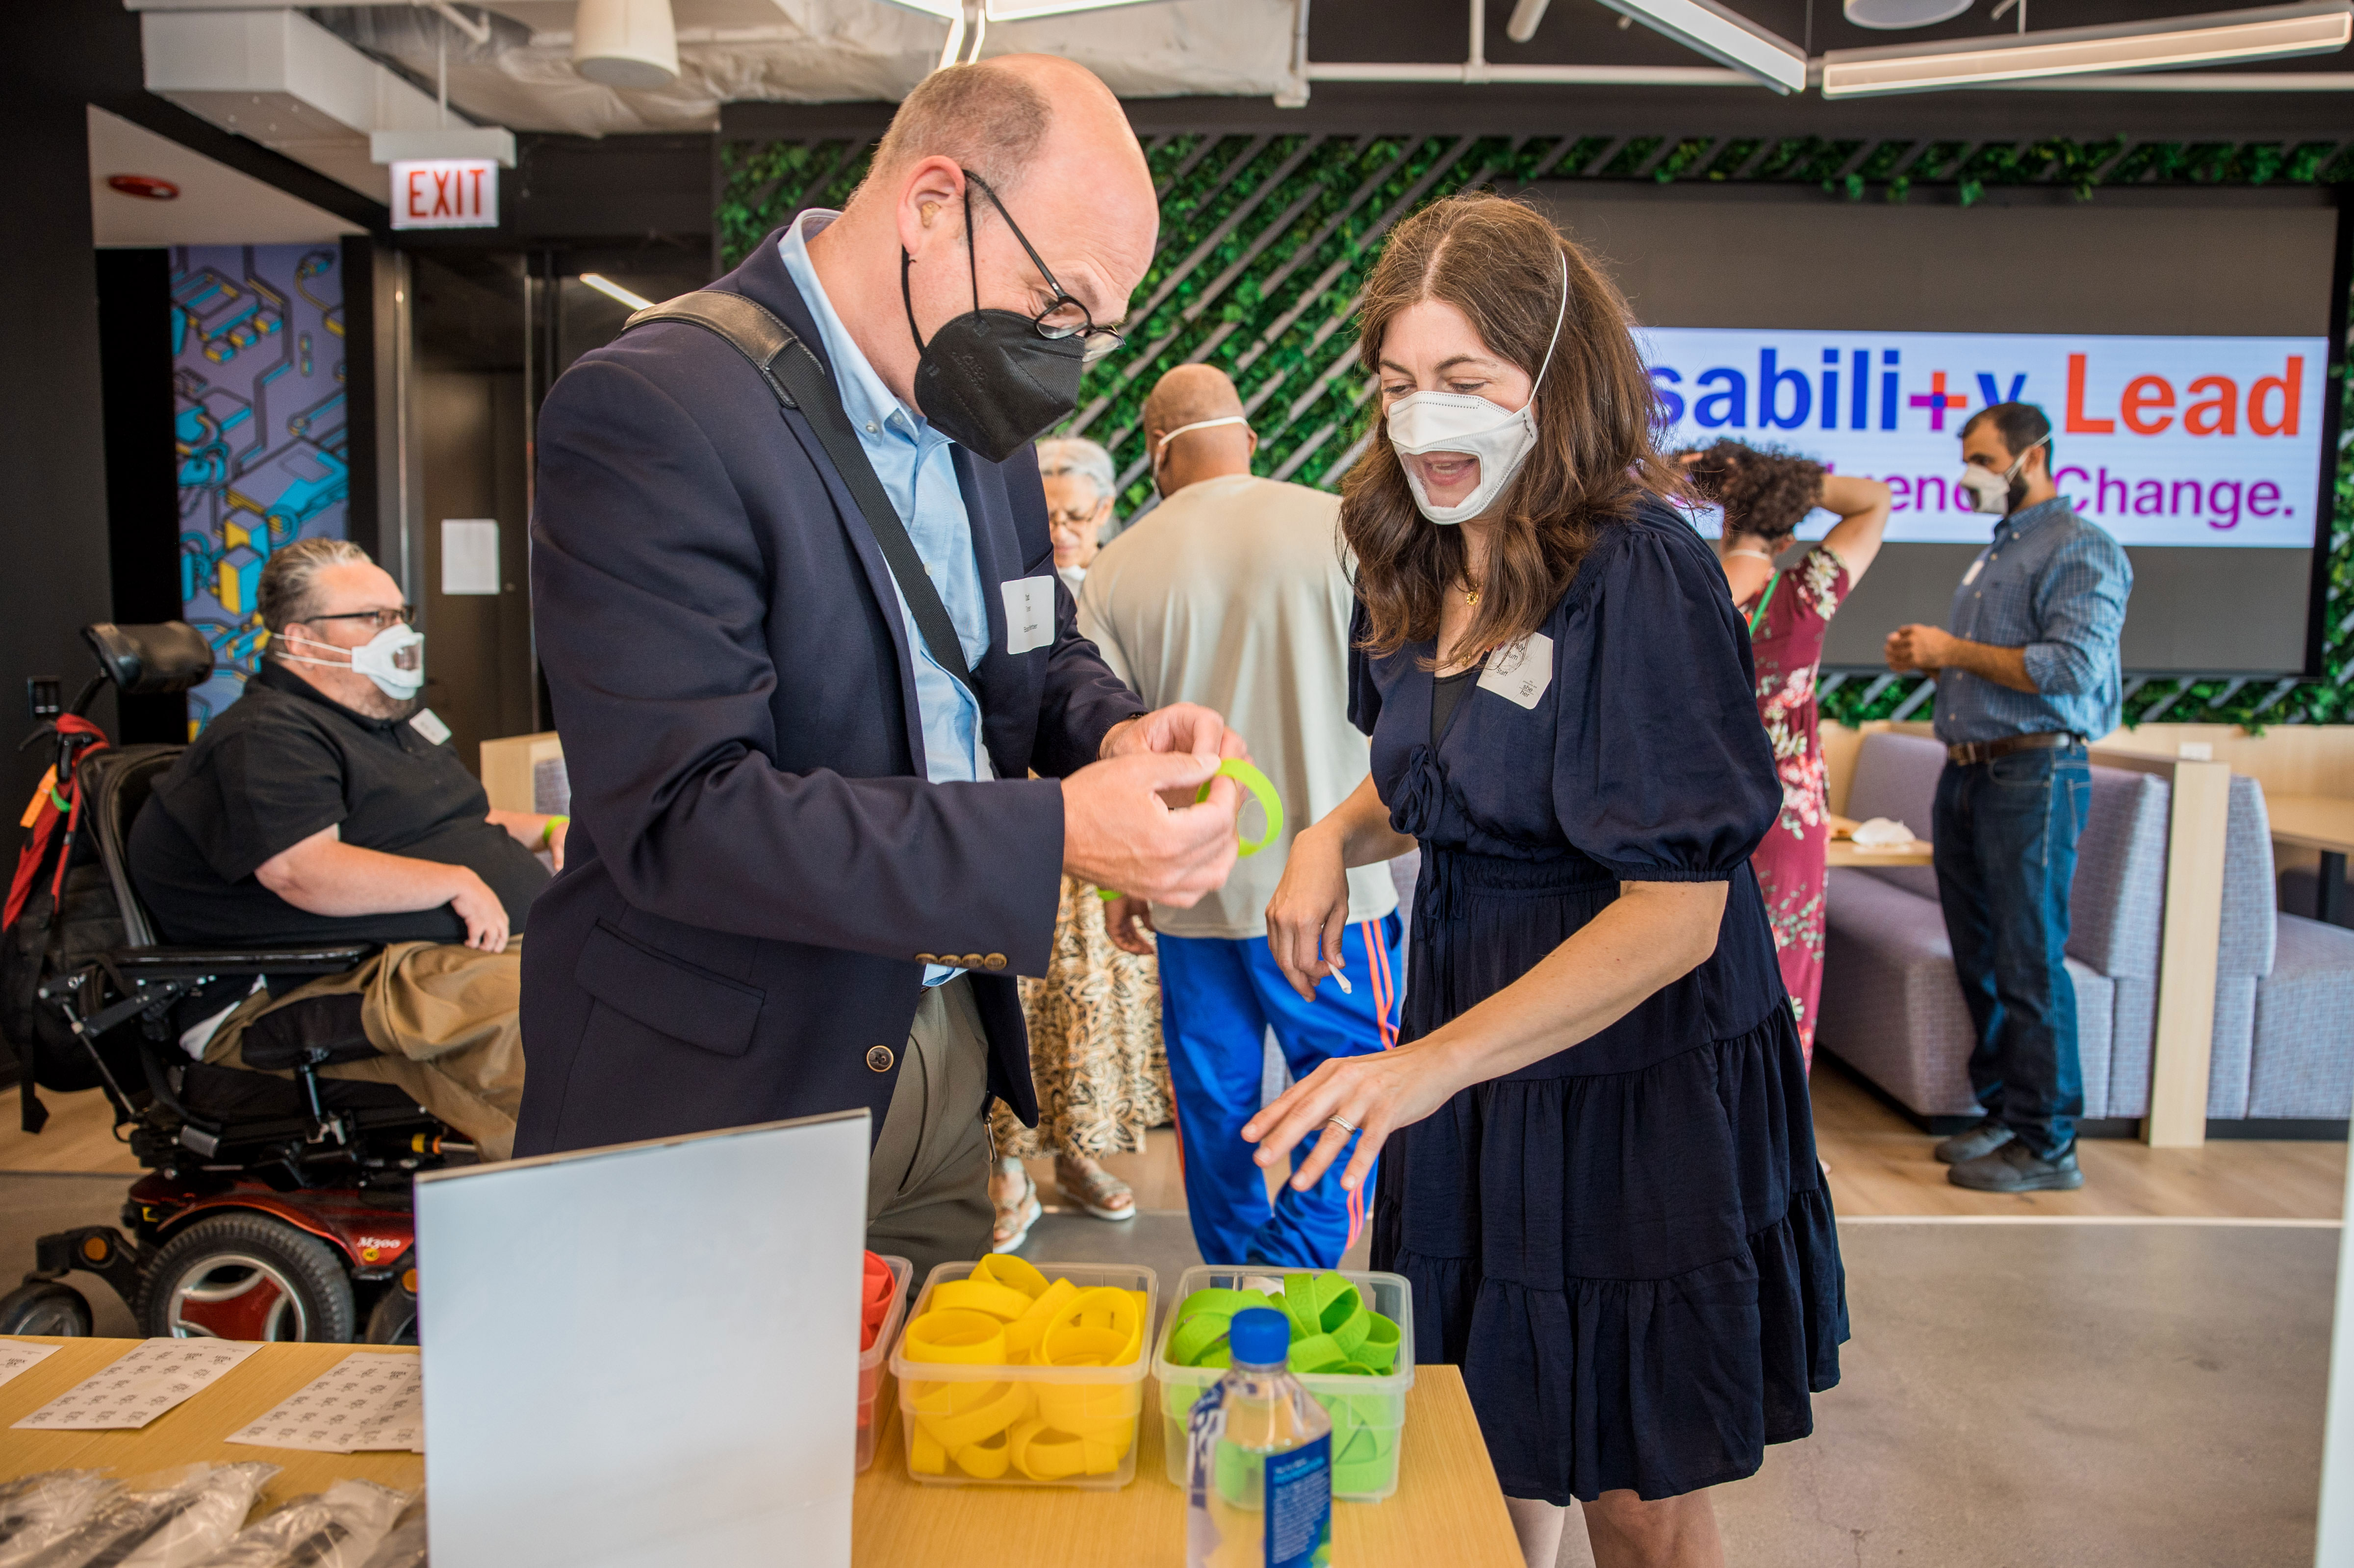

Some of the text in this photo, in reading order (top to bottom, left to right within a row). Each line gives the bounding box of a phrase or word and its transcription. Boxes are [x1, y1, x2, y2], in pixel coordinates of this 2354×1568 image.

[409, 169, 485, 217] EXIT
[2065, 352, 2304, 436] Lead
[2054, 466, 2294, 530] Change.
[1512, 642, 1525, 652] mily
[1507, 652, 1518, 661] lum
[1496, 667, 1509, 677] Staff
[1520, 689, 1530, 698] her
[357, 1237, 401, 1250] M300
